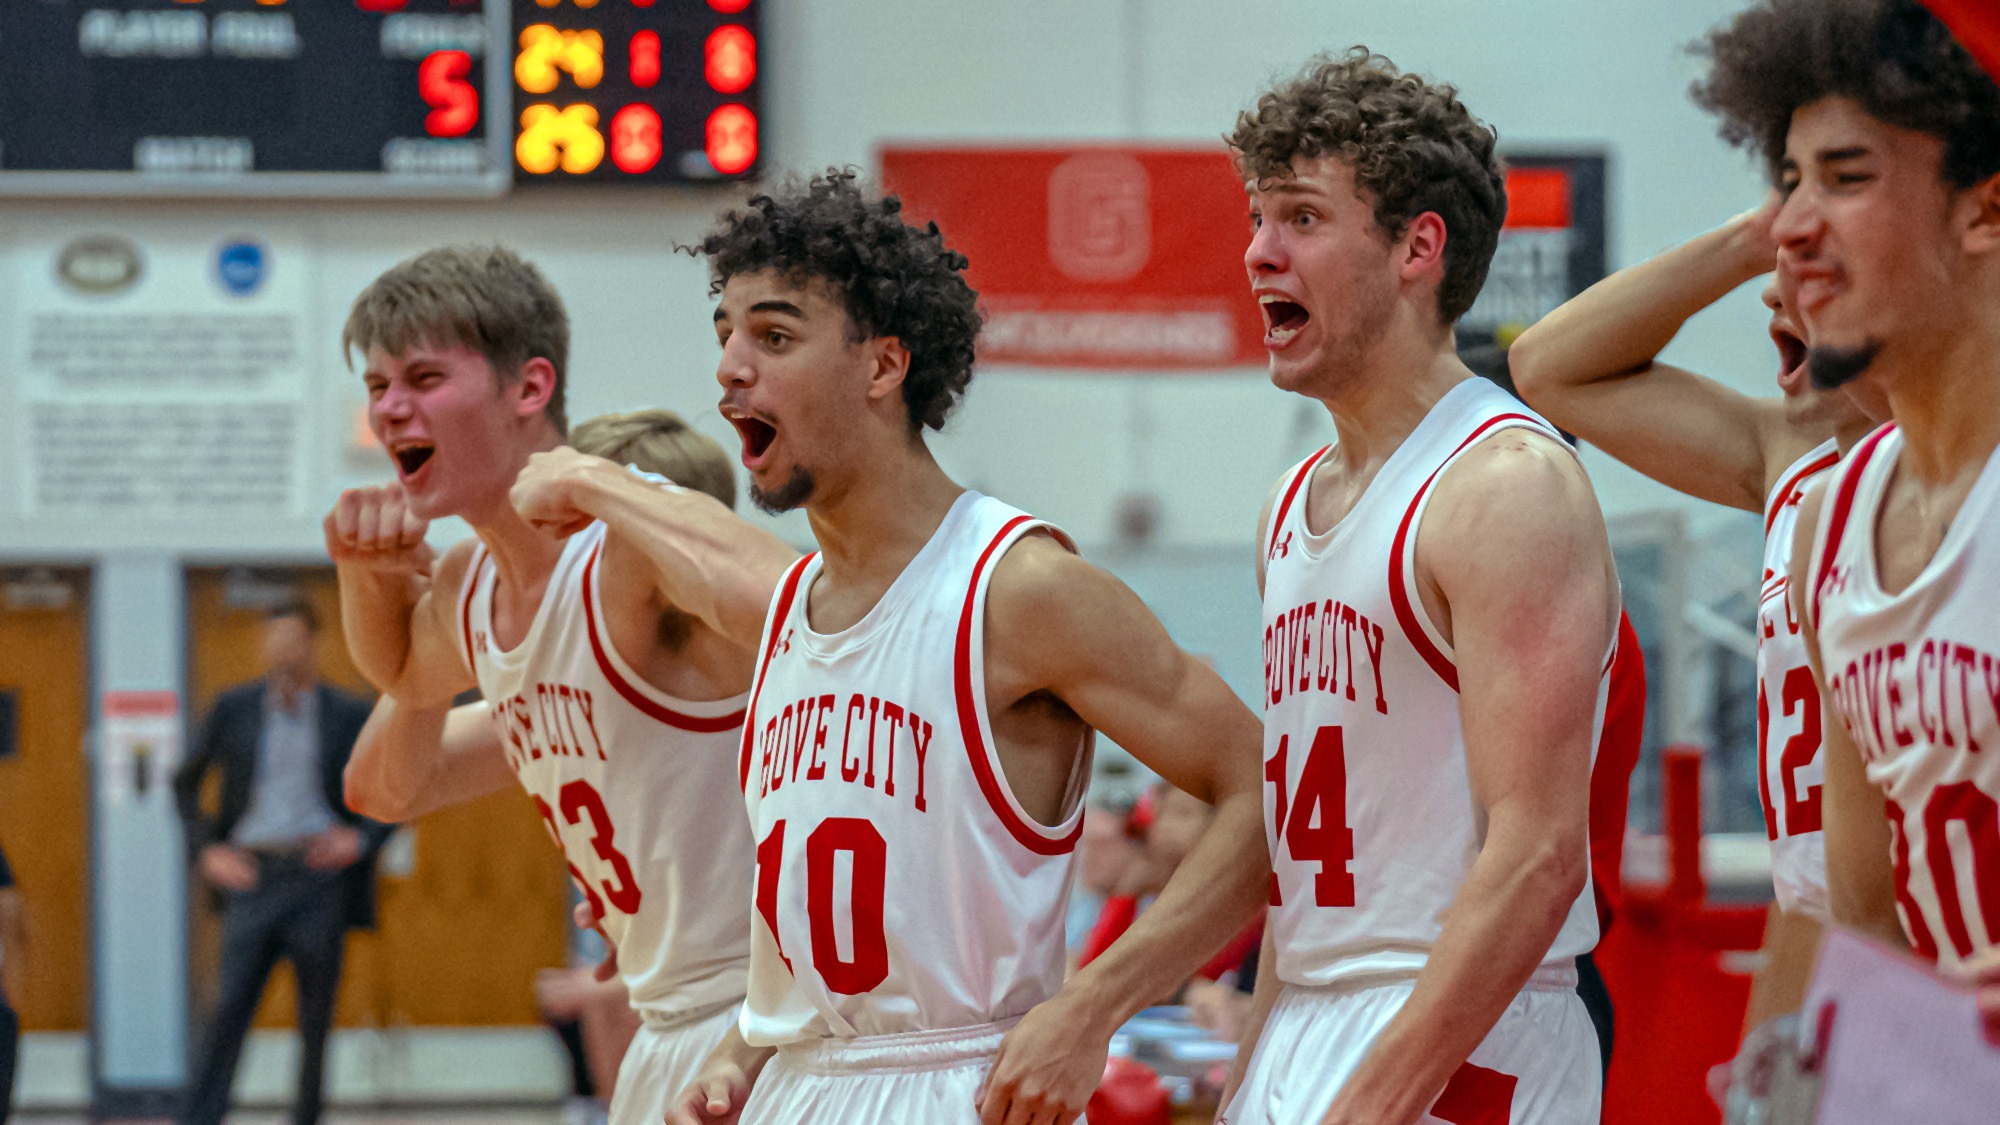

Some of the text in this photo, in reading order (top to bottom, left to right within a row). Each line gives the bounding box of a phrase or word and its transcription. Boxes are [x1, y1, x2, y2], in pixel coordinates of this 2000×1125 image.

[537, 683, 607, 761] CITY
[1262, 599, 1388, 715] ROVE CITY
[760, 693, 933, 813] ROVE CITY
[1264, 725, 1356, 907] 14
[1757, 665, 1823, 841] 12
[756, 817, 889, 995] 10
